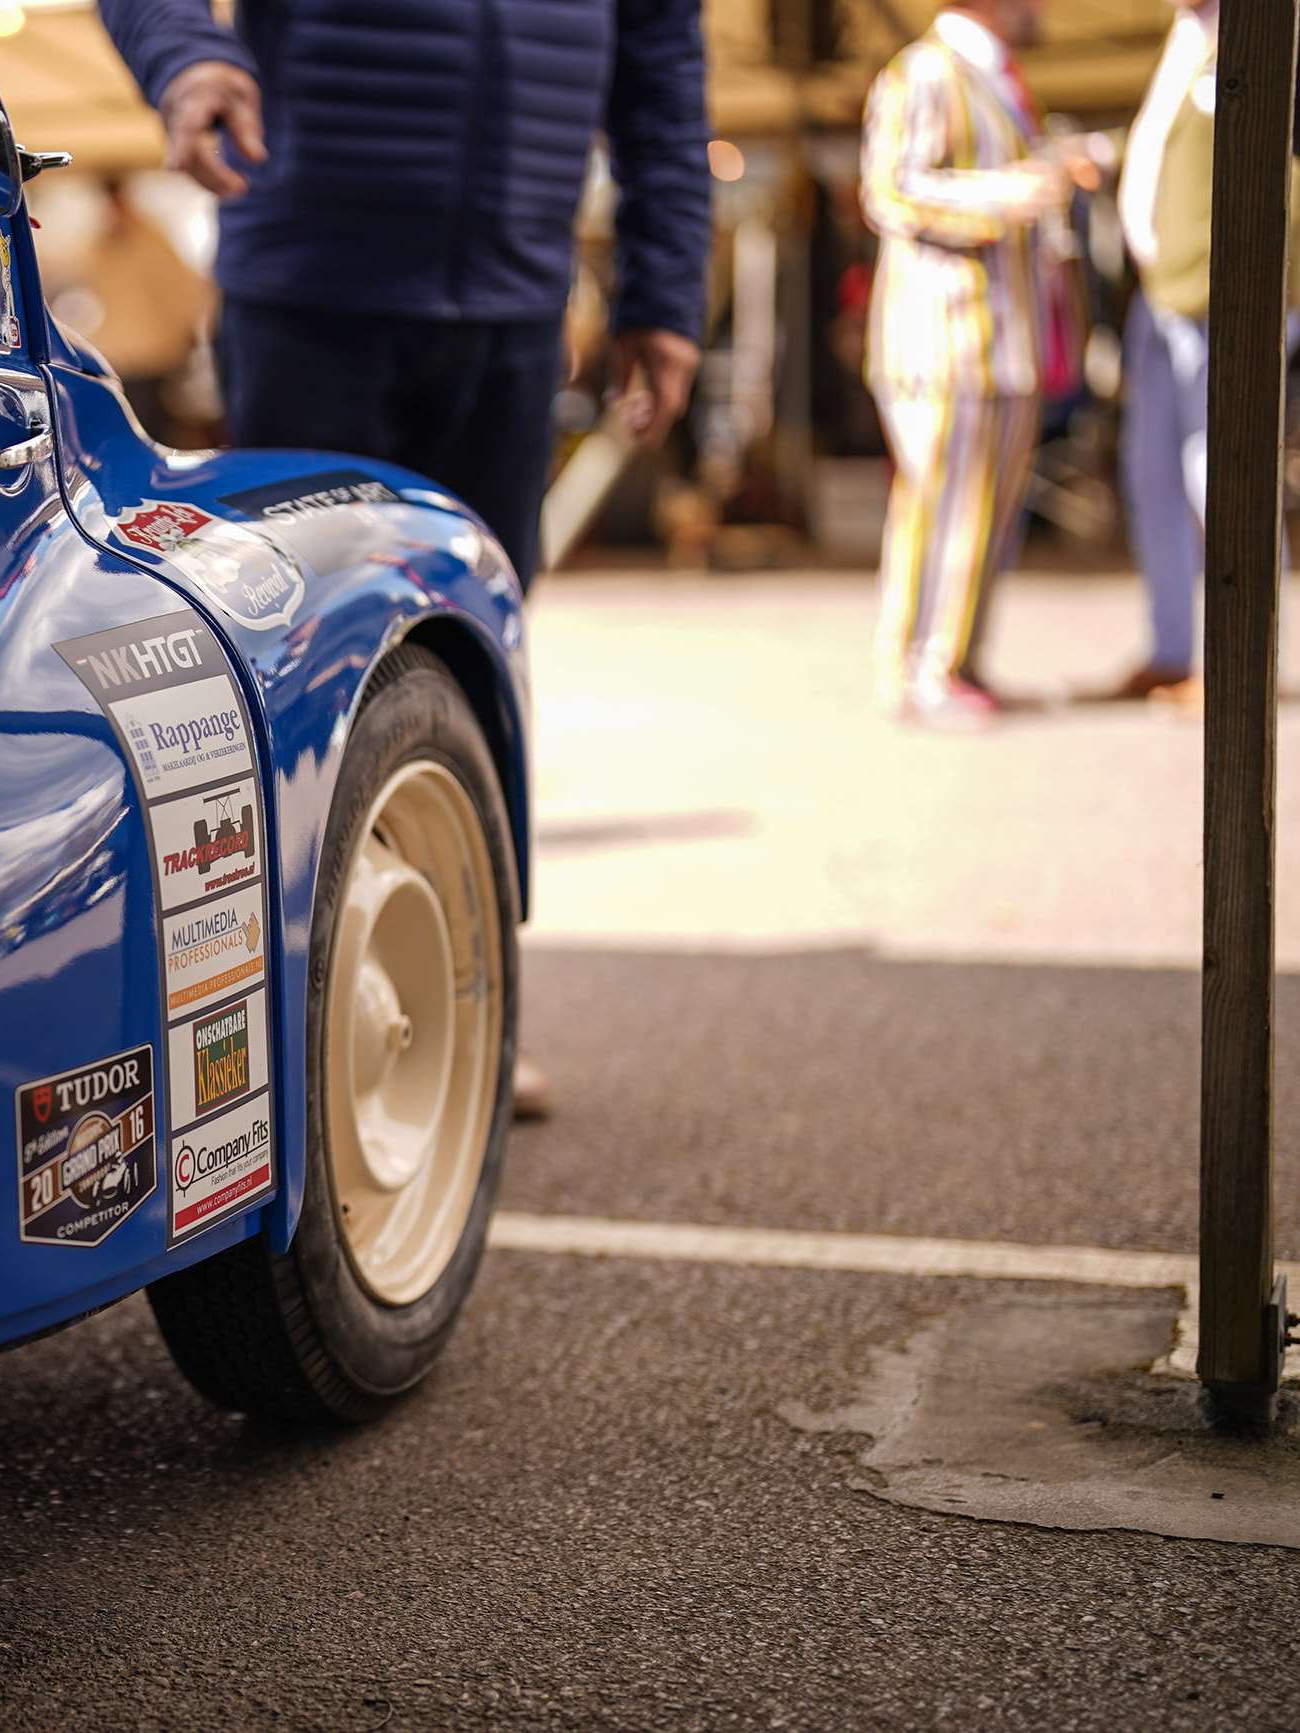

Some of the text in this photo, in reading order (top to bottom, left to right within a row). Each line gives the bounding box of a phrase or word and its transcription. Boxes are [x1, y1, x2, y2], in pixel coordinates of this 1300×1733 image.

[148, 709, 241, 754] Rappange
[171, 907, 238, 951] MULTIMEDIA
[168, 930, 243, 975] PROFESSIONALS
[196, 1010, 246, 1050] ONSCHATBARE
[56, 1059, 140, 1112] TUDOR
[196, 1037, 247, 1105] Klassieker
[129, 1105, 144, 1144] 16
[197, 1130, 251, 1174] Company
[252, 1120, 269, 1146] Fits
[31, 1168, 53, 1211] 20
[57, 1202, 129, 1239] COMPETITOR
